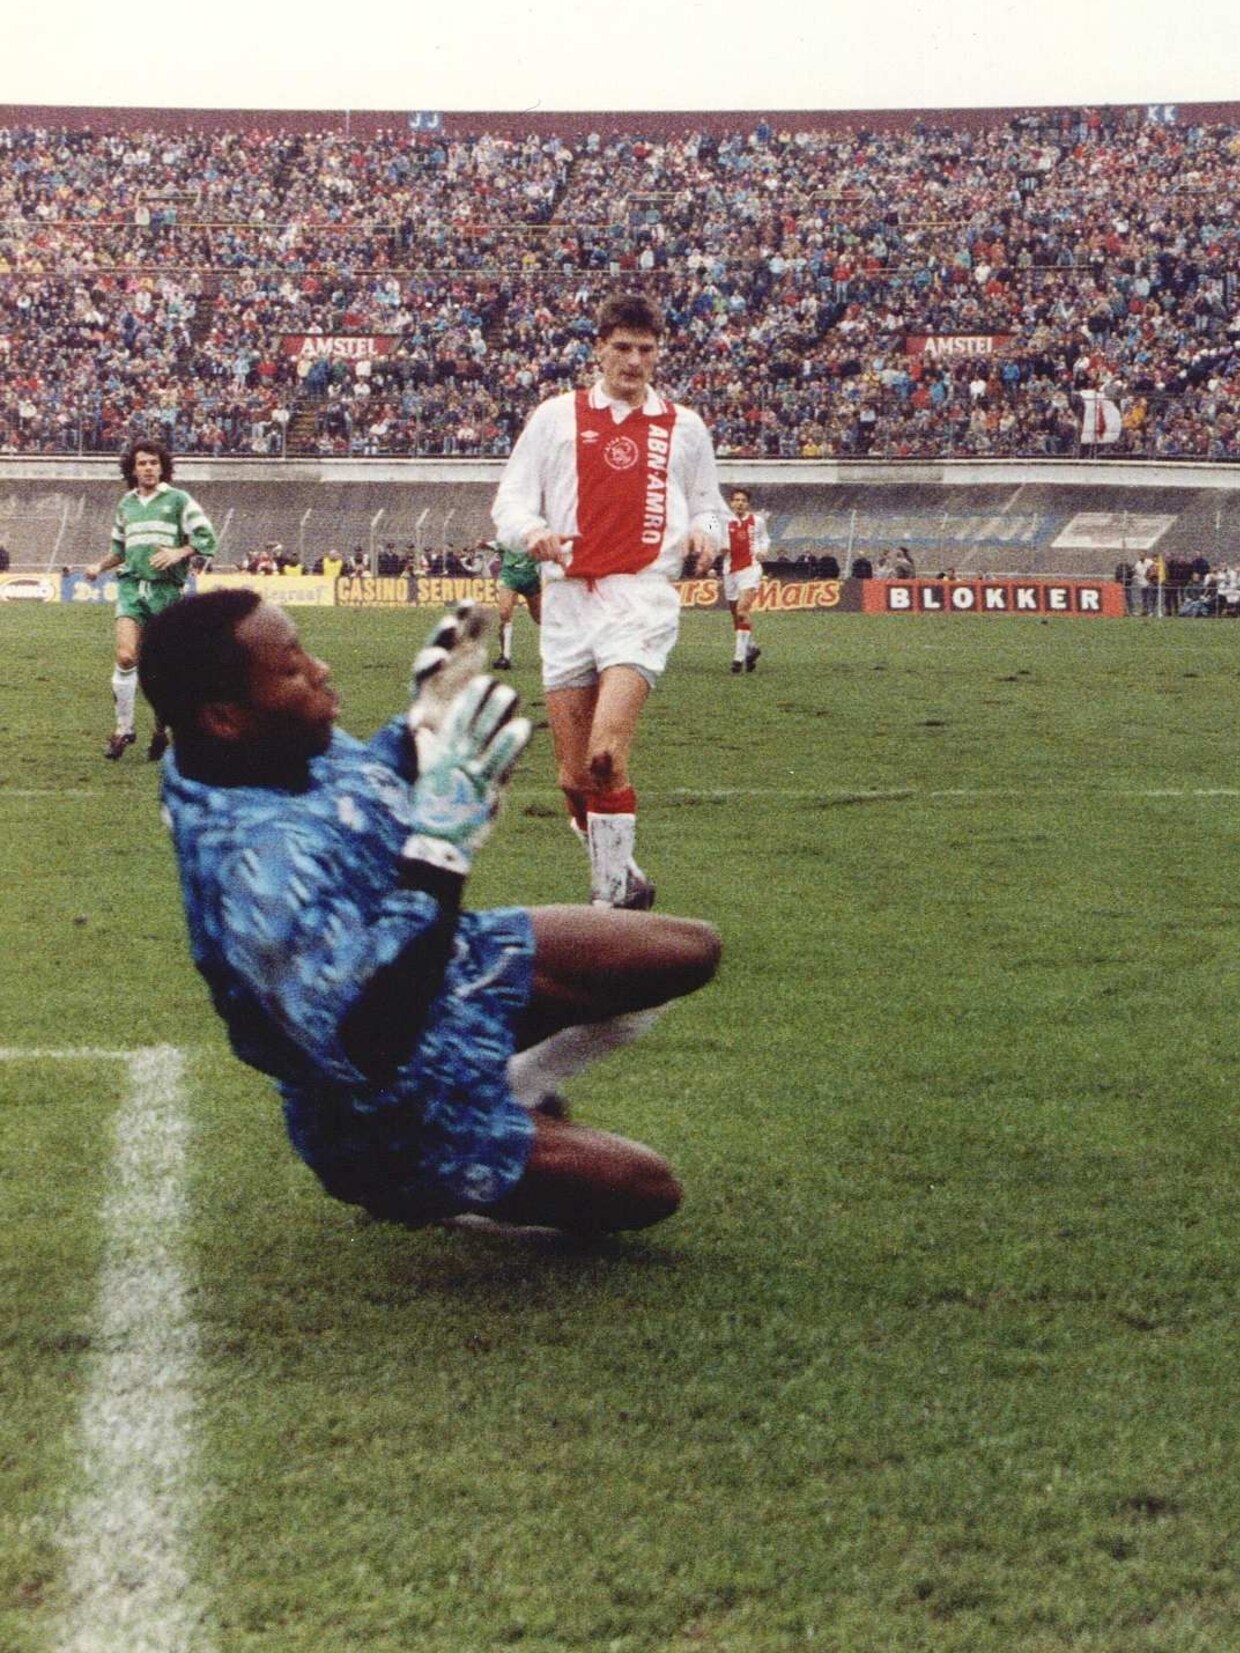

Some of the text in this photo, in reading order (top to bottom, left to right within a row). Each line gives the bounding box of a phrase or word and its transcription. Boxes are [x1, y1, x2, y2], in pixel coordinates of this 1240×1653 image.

[301, 337, 378, 357] AMSTEL
[336, 577, 409, 602] CASINO
[750, 579, 841, 611] Mars
[889, 587, 1100, 611] BLOKKER
